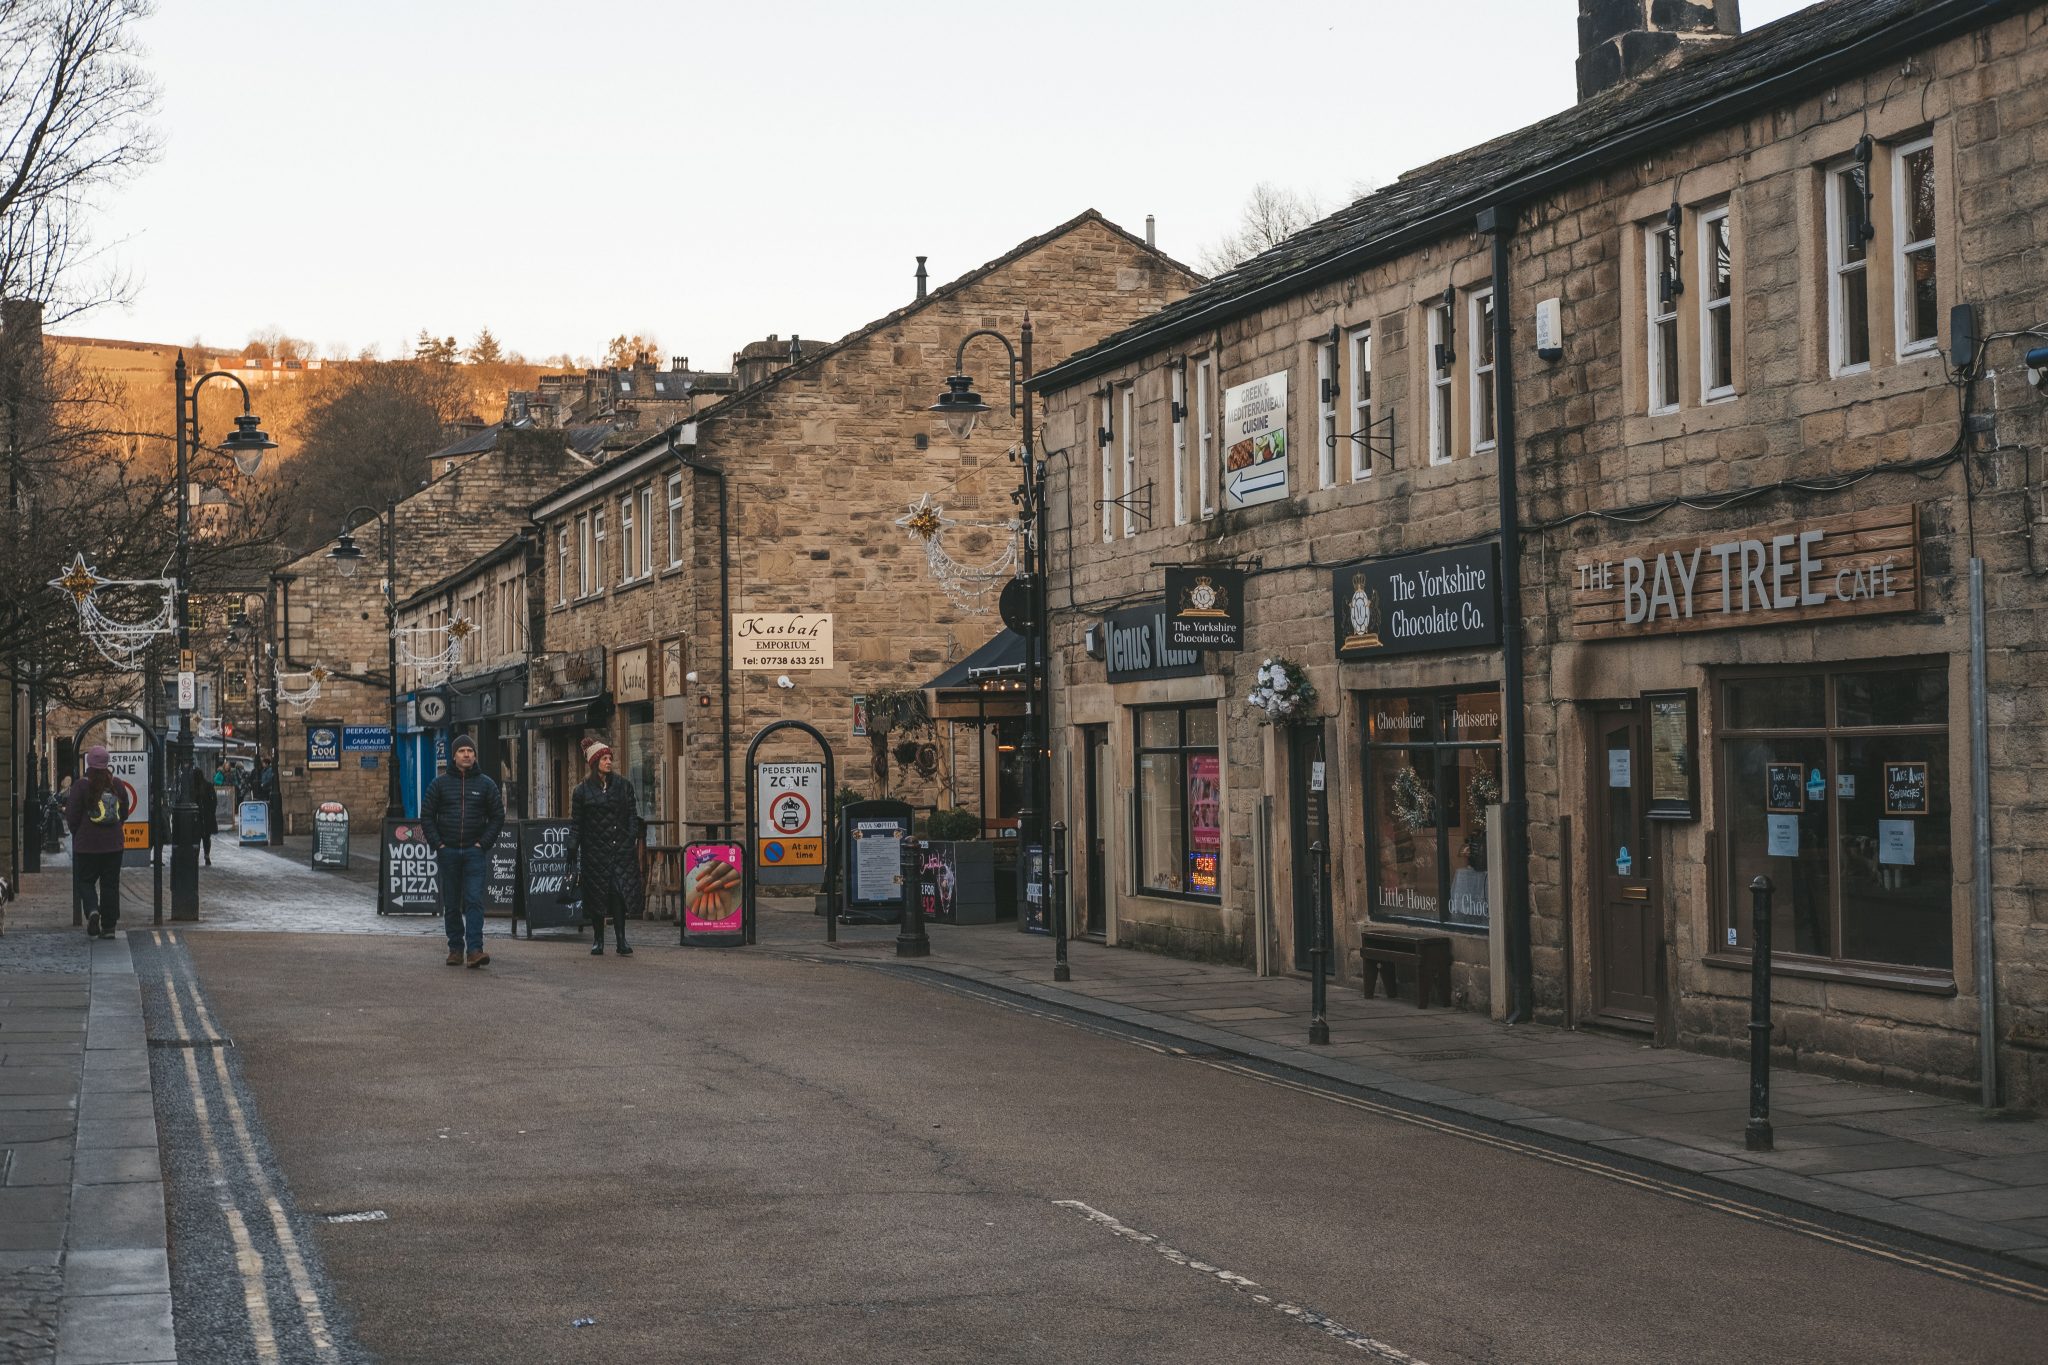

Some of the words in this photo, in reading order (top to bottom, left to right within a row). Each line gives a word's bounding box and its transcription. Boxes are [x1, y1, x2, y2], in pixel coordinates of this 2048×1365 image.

[1227, 394, 1285, 424] MEDITERRANEAN
[1242, 415, 1269, 435] CUISINE
[1390, 573, 1415, 602] The
[1418, 564, 1486, 598] Yorkshire
[1577, 561, 1613, 592] THE
[1623, 547, 1702, 625] BAY
[1710, 529, 1827, 614] TREE
[1835, 555, 1896, 602] CAFÉ
[738, 615, 828, 637] Kasbah
[1173, 622, 1191, 632] The
[1193, 622, 1237, 632] Yorkshire
[1392, 605, 1458, 638] Chocolate
[1461, 602, 1485, 630] Co.
[756, 641, 810, 649] EMPORIUM
[1104, 621, 1151, 672] Venus
[1174, 633, 1219, 643] Chocolate
[1221, 634, 1236, 644] Co.
[742, 657, 758, 665] Tel:
[760, 657, 788, 665] 07738
[790, 657, 806, 665] 633
[809, 657, 824, 665] 251
[1377, 711, 1425, 730] Chocolatier
[1452, 709, 1498, 728] Patisserie
[311, 744, 336, 756] Food
[108, 755, 144, 763] STRIAN
[108, 764, 136, 775] ONE
[762, 766, 818, 774] PEDESTRIAN
[533, 843, 568, 859] SOPH
[803, 843, 818, 851] any
[389, 860, 438, 876] FIRED
[390, 877, 439, 893] PIZZA
[529, 876, 563, 894] LUNCH
[925, 884, 935, 895] FOR
[1379, 887, 1404, 908] Little
[1406, 889, 1437, 911] House
[1448, 893, 1460, 914] of
